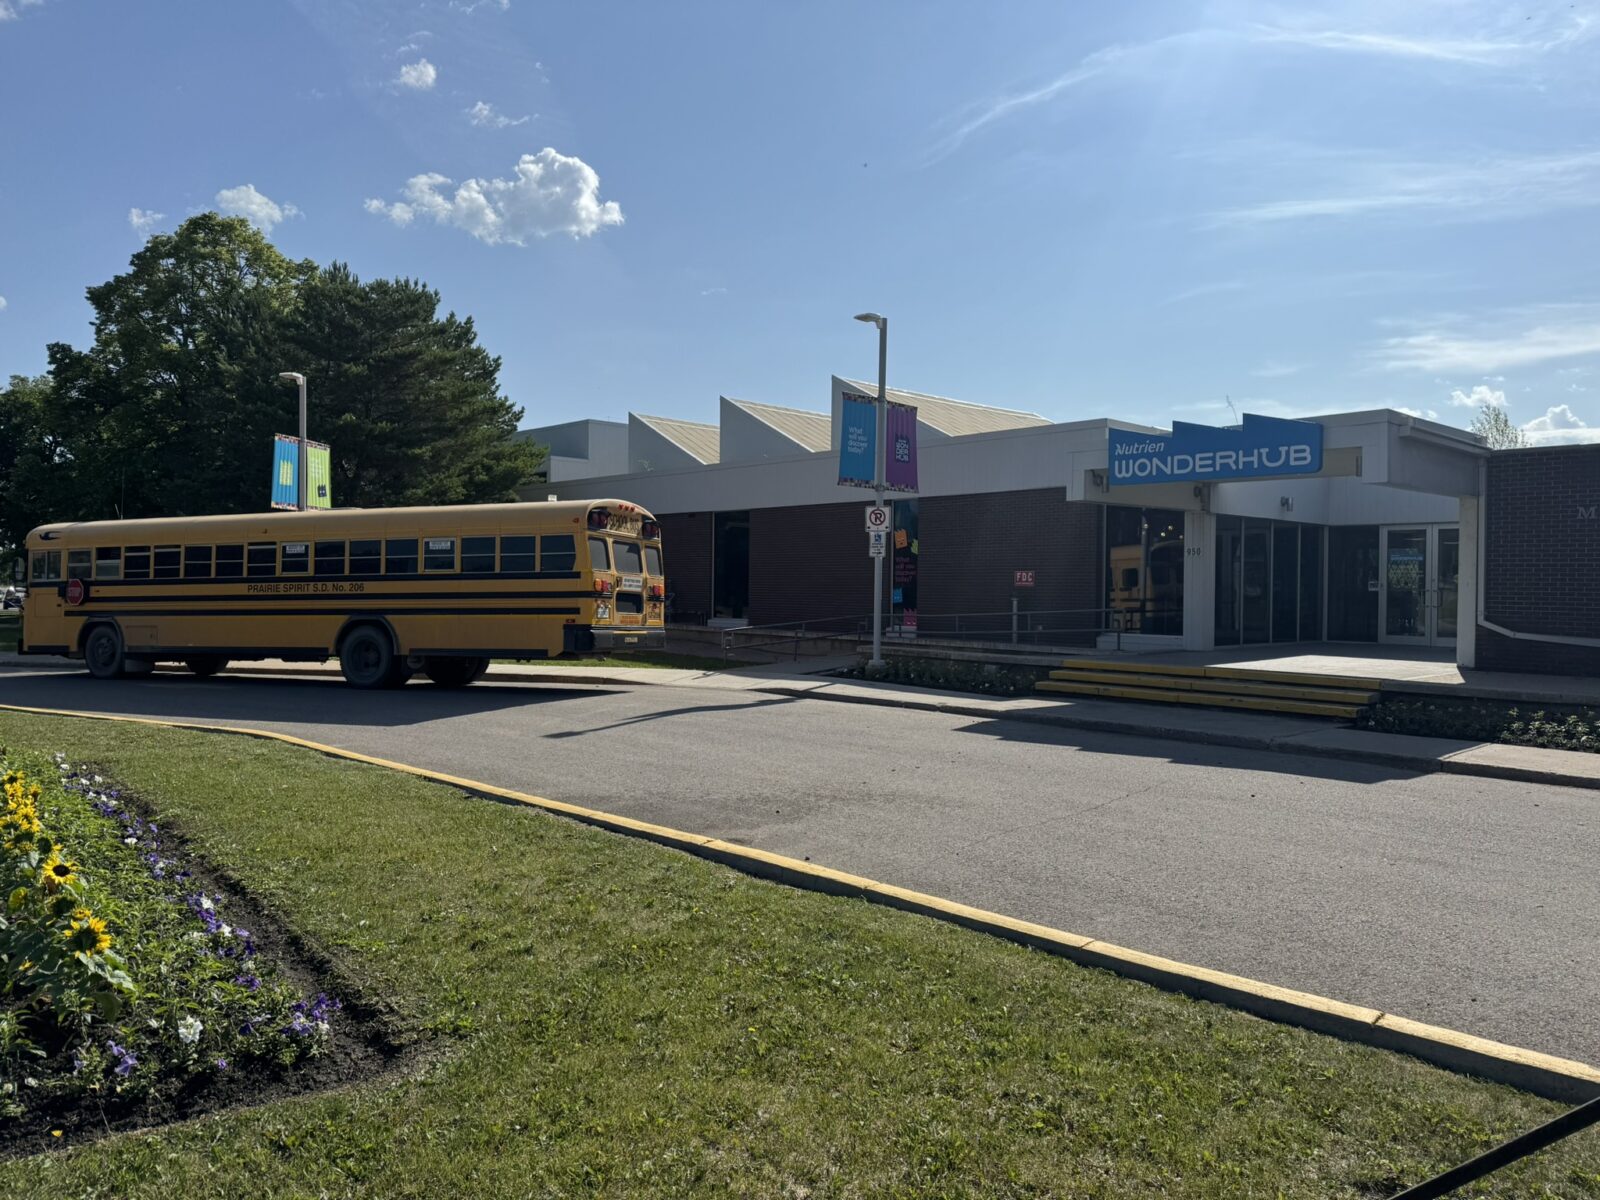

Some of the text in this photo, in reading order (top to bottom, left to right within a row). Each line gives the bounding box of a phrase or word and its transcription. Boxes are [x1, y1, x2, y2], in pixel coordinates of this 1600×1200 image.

[848, 426, 863, 434] What
[1114, 440, 1165, 456] Nutrien
[1114, 444, 1312, 478] WONDERHUB
[1186, 547, 1200, 555] 950
[1016, 572, 1033, 581] FDC
[247, 583, 365, 593] PRAIRIE SPIRIT S.D. No. 206
